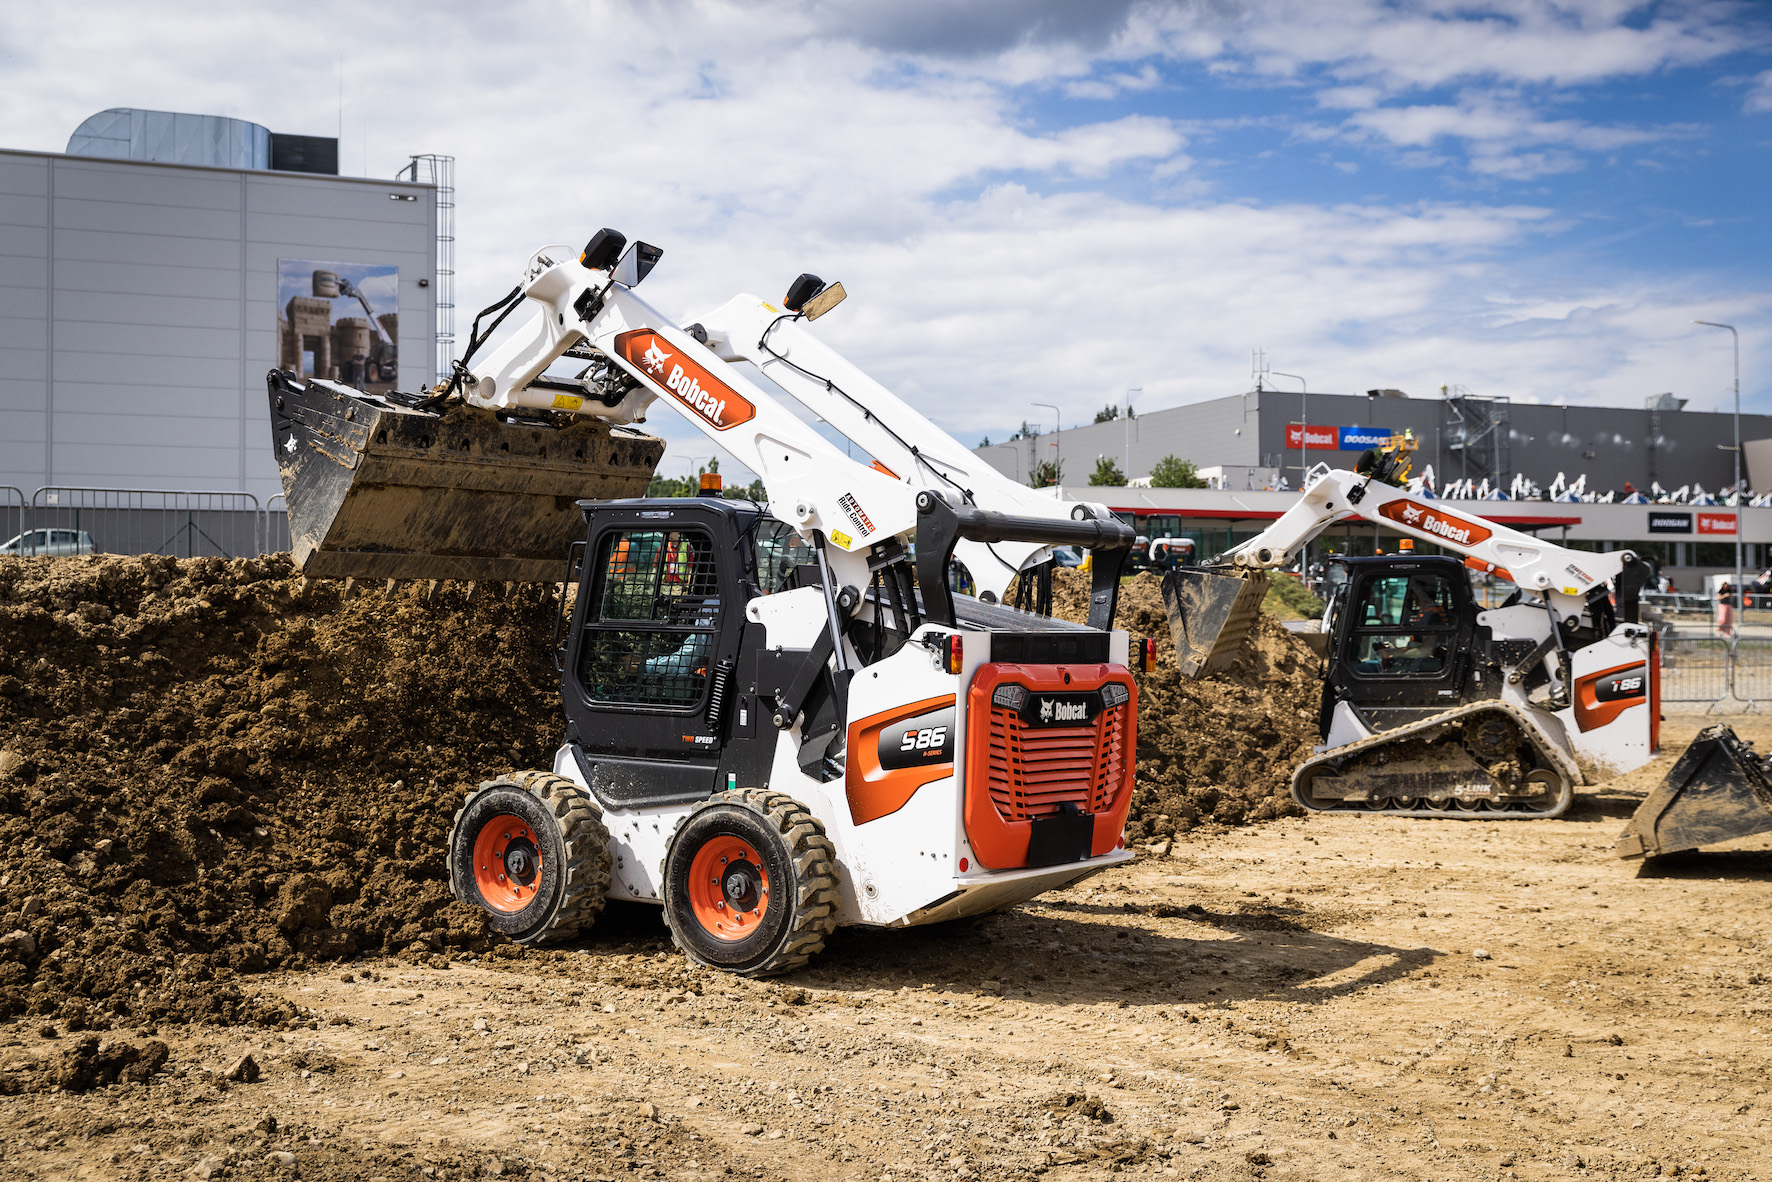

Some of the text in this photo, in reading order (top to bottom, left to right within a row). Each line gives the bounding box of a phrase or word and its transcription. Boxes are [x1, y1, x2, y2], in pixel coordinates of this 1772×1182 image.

[666, 363, 726, 425] Bobcat
[1304, 432, 1333, 444] Bobcat
[838, 496, 870, 538] Ride Control
[845, 493, 876, 532] AUTOMATIC
[1423, 515, 1471, 544] Bobcat
[1611, 677, 1642, 692] T86
[1055, 701, 1087, 721] Bobcat
[681, 735, 713, 744] TWO SPEED
[900, 726, 948, 751] S86
[1453, 784, 1491, 796] 5-LINK
